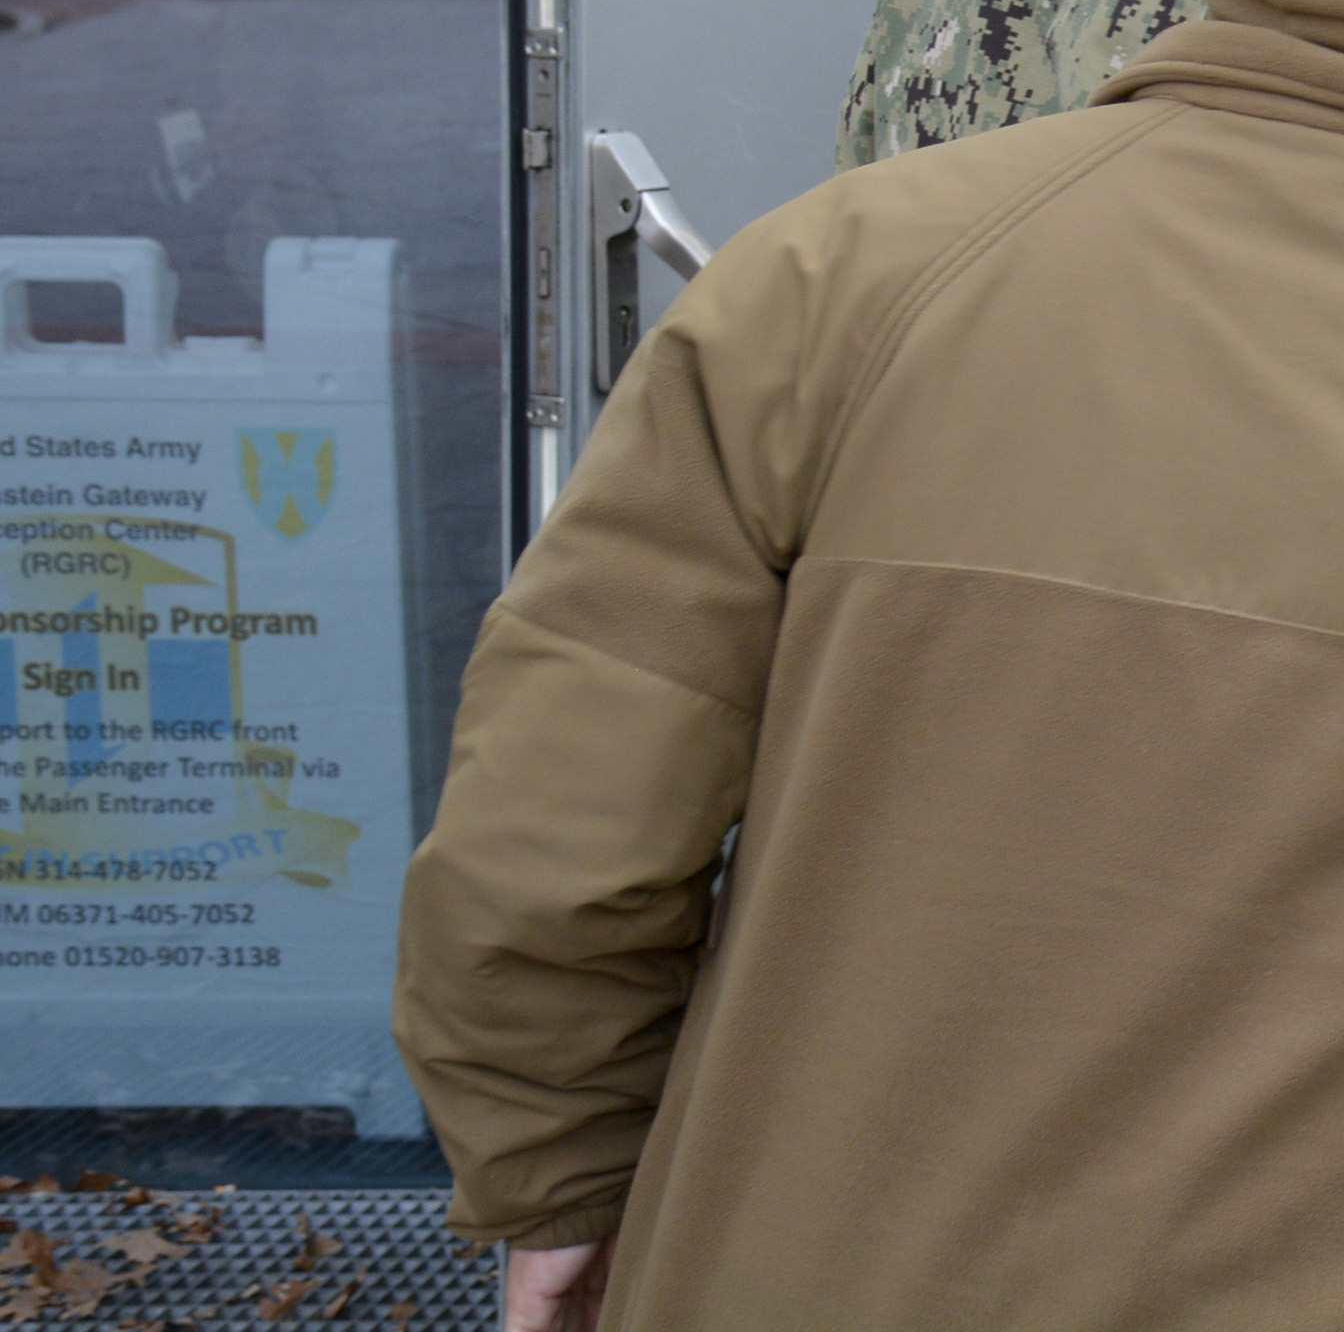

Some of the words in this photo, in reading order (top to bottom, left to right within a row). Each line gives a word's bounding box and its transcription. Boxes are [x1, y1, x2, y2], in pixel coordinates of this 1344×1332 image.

[26, 435, 117, 458] States
[125, 436, 203, 464] Army
[0, 484, 73, 506] stein
[83, 483, 206, 512] Gateway
[0, 518, 94, 544] eption
[104, 518, 200, 542] Center
[21, 552, 131, 579] (RGRC)
[169, 606, 318, 640] Program
[22, 662, 97, 697] Sign
[107, 663, 140, 691] In
[63, 722, 91, 741] to
[99, 721, 143, 741] the
[152, 720, 226, 741] RGRC
[234, 720, 298, 742] front
[35, 757, 168, 783] Passenger
[178, 757, 294, 779] Terminal
[302, 758, 340, 779] via
[20, 793, 89, 814] Main
[98, 793, 214, 814] Entrance
[37, 859, 217, 881] 314-478-7052
[37, 903, 255, 925] 06371-405-7052
[64, 946, 281, 968] 01520-907-3138
